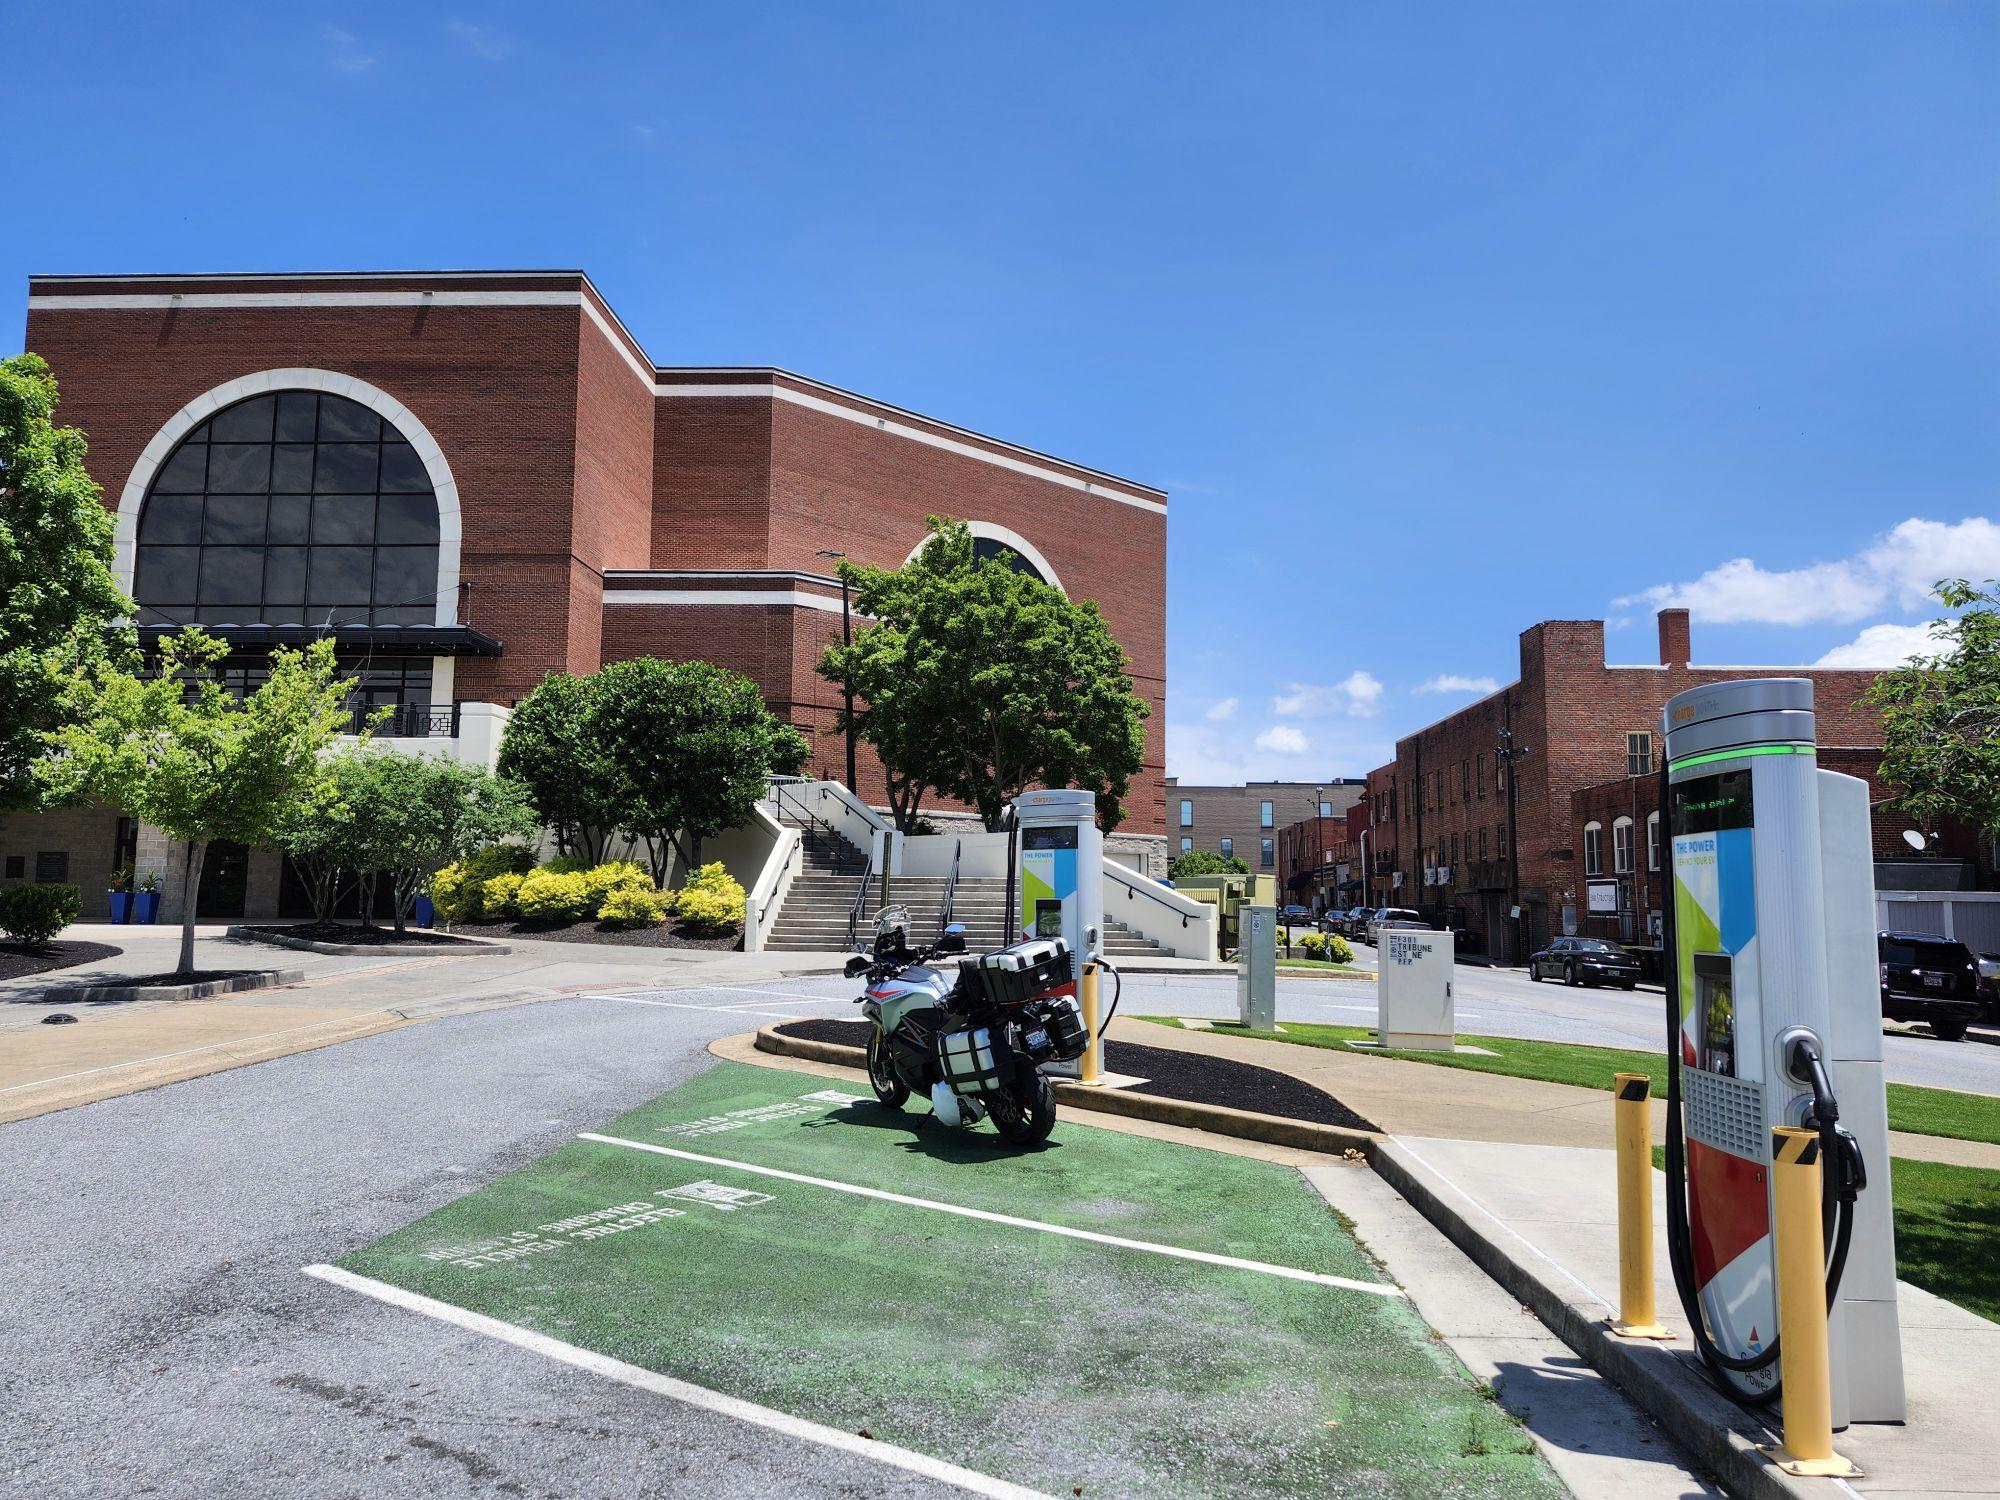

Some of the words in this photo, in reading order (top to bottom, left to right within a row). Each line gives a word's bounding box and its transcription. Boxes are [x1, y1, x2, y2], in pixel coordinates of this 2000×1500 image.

[1676, 842, 1688, 854] THE
[1689, 839, 1715, 853] POWER
[1397, 943, 1432, 952] TRIBUNE
[1397, 950, 1407, 958] ST
[1412, 951, 1422, 959] NE
[538, 1201, 655, 1233] CHARGING
[569, 1207, 687, 1240] ELECTRIC
[450, 1238, 572, 1269] VEHICLE
